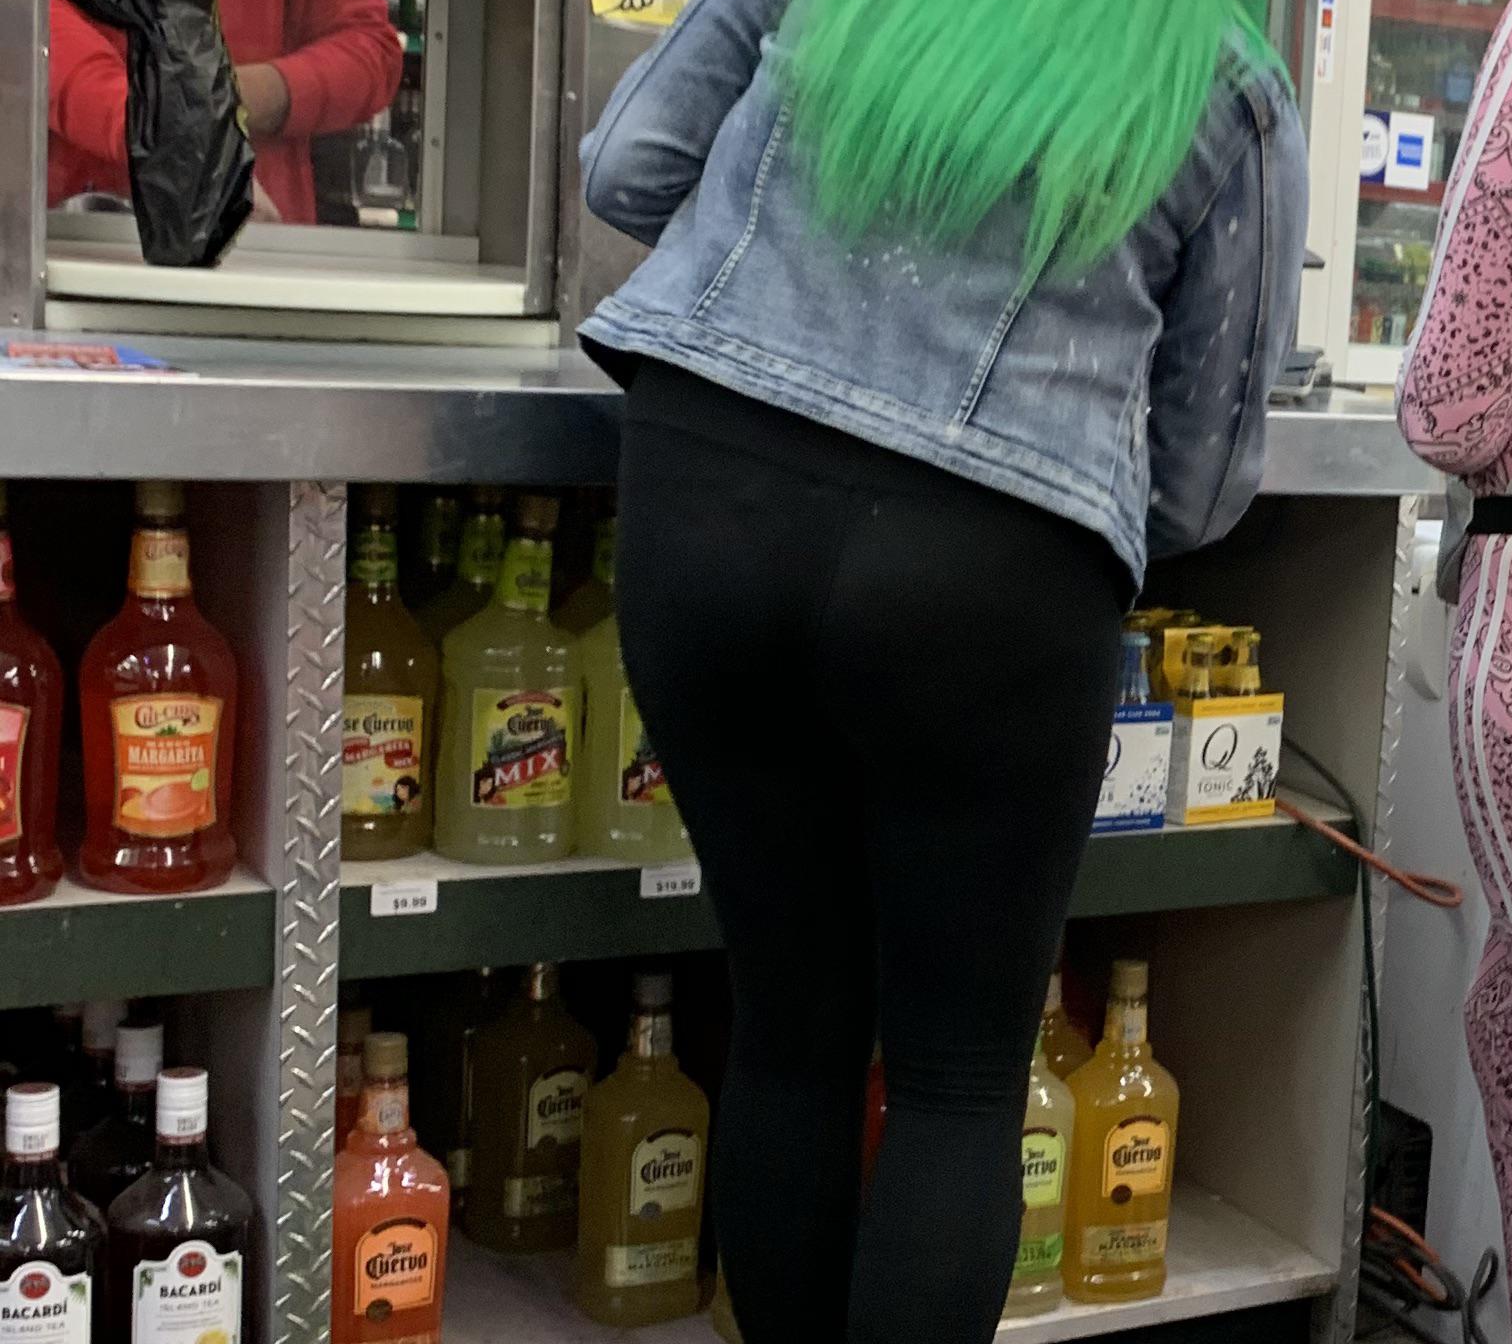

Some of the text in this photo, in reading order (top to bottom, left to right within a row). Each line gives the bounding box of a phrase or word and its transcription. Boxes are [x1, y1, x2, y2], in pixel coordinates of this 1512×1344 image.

[362, 713, 414, 734] Cuervo
[127, 744, 205, 765] MARGARITA
[1202, 723, 1239, 770] Q
[493, 748, 562, 787] MIX
[1197, 779, 1234, 794] TONIC
[1112, 1144, 1162, 1167] Cuervo
[640, 1159, 694, 1184] Cuervo
[1022, 1157, 1058, 1177] ervo
[387, 1242, 413, 1254] Jose
[364, 1254, 429, 1280] Cuervo
[160, 1279, 222, 1299] BACARDÍ
[1, 1298, 68, 1320] BACARDÍ
